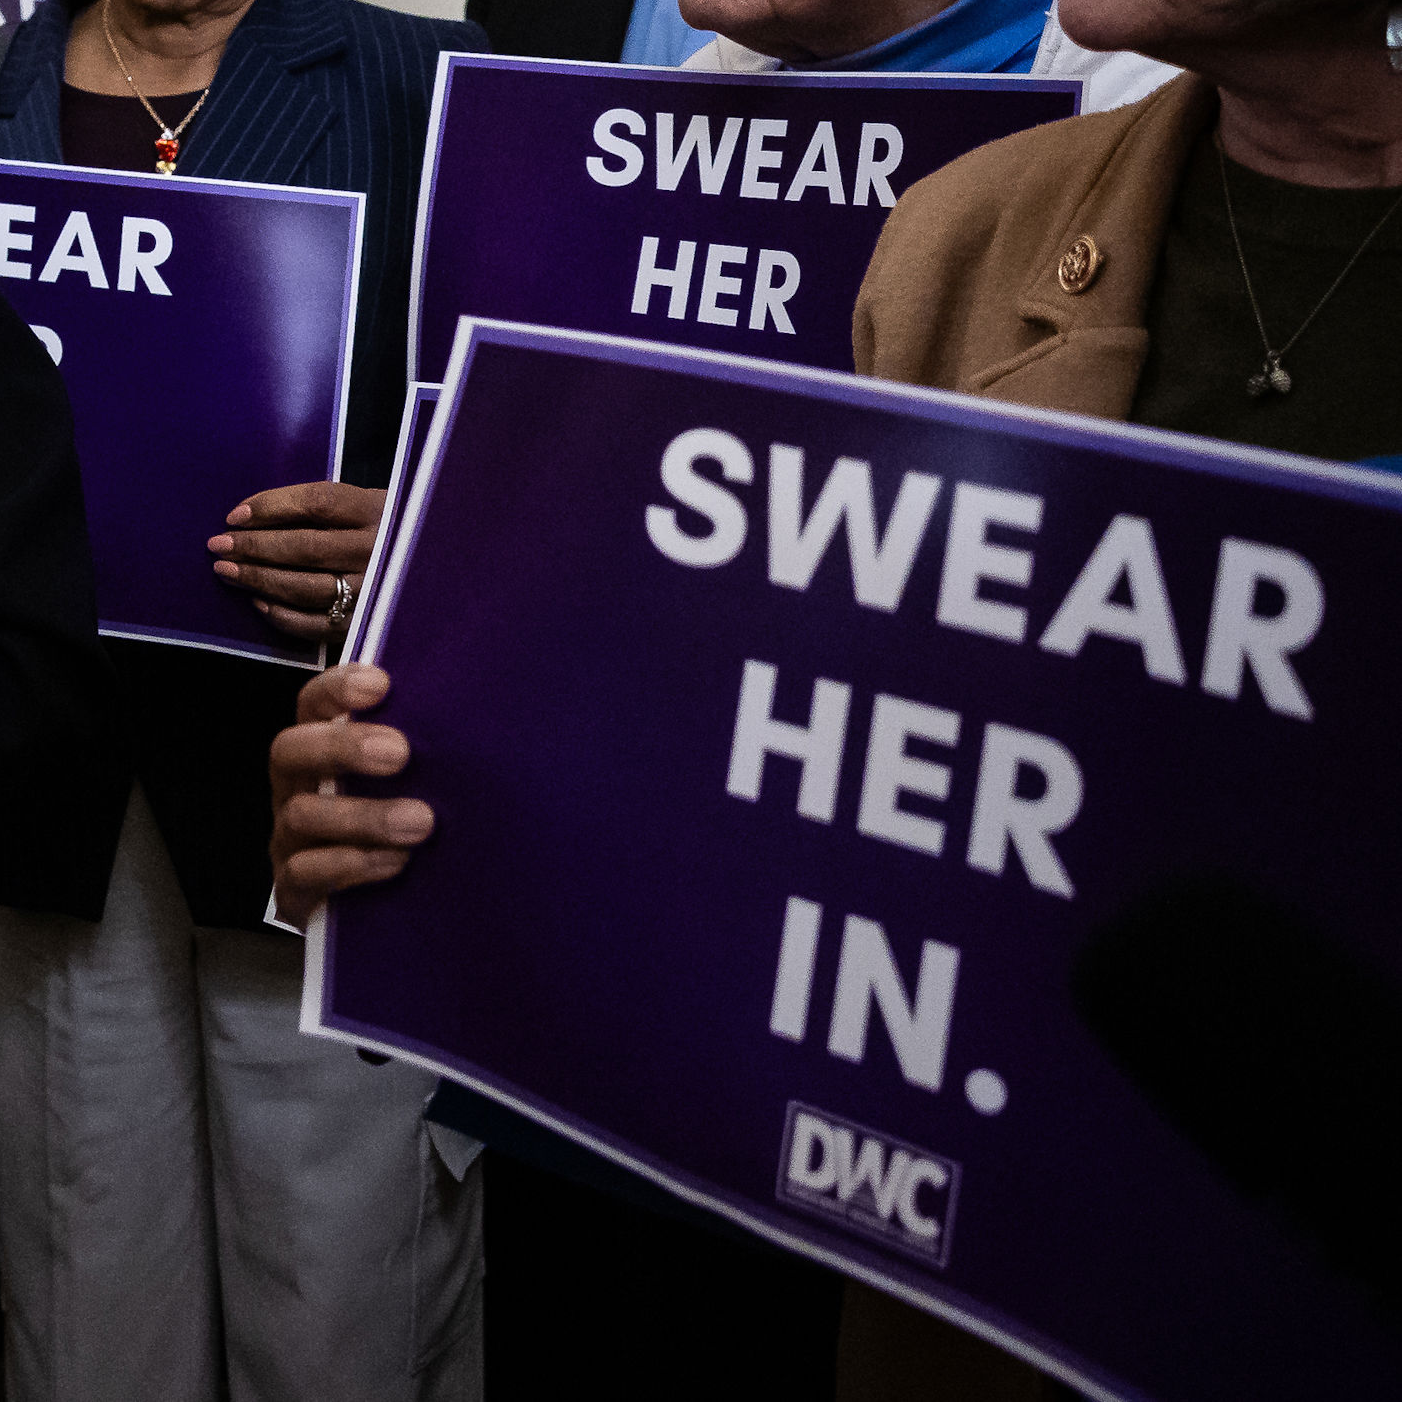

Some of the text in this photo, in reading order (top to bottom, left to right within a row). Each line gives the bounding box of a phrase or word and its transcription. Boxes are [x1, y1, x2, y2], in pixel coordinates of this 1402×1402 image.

[586, 108, 904, 208] SWEAR
[630, 236, 801, 335] HER
[644, 426, 1327, 722] SWEAR
[725, 659, 1085, 899] HER
[769, 896, 1009, 1116] IN.
[788, 1112, 948, 1238] DWC
